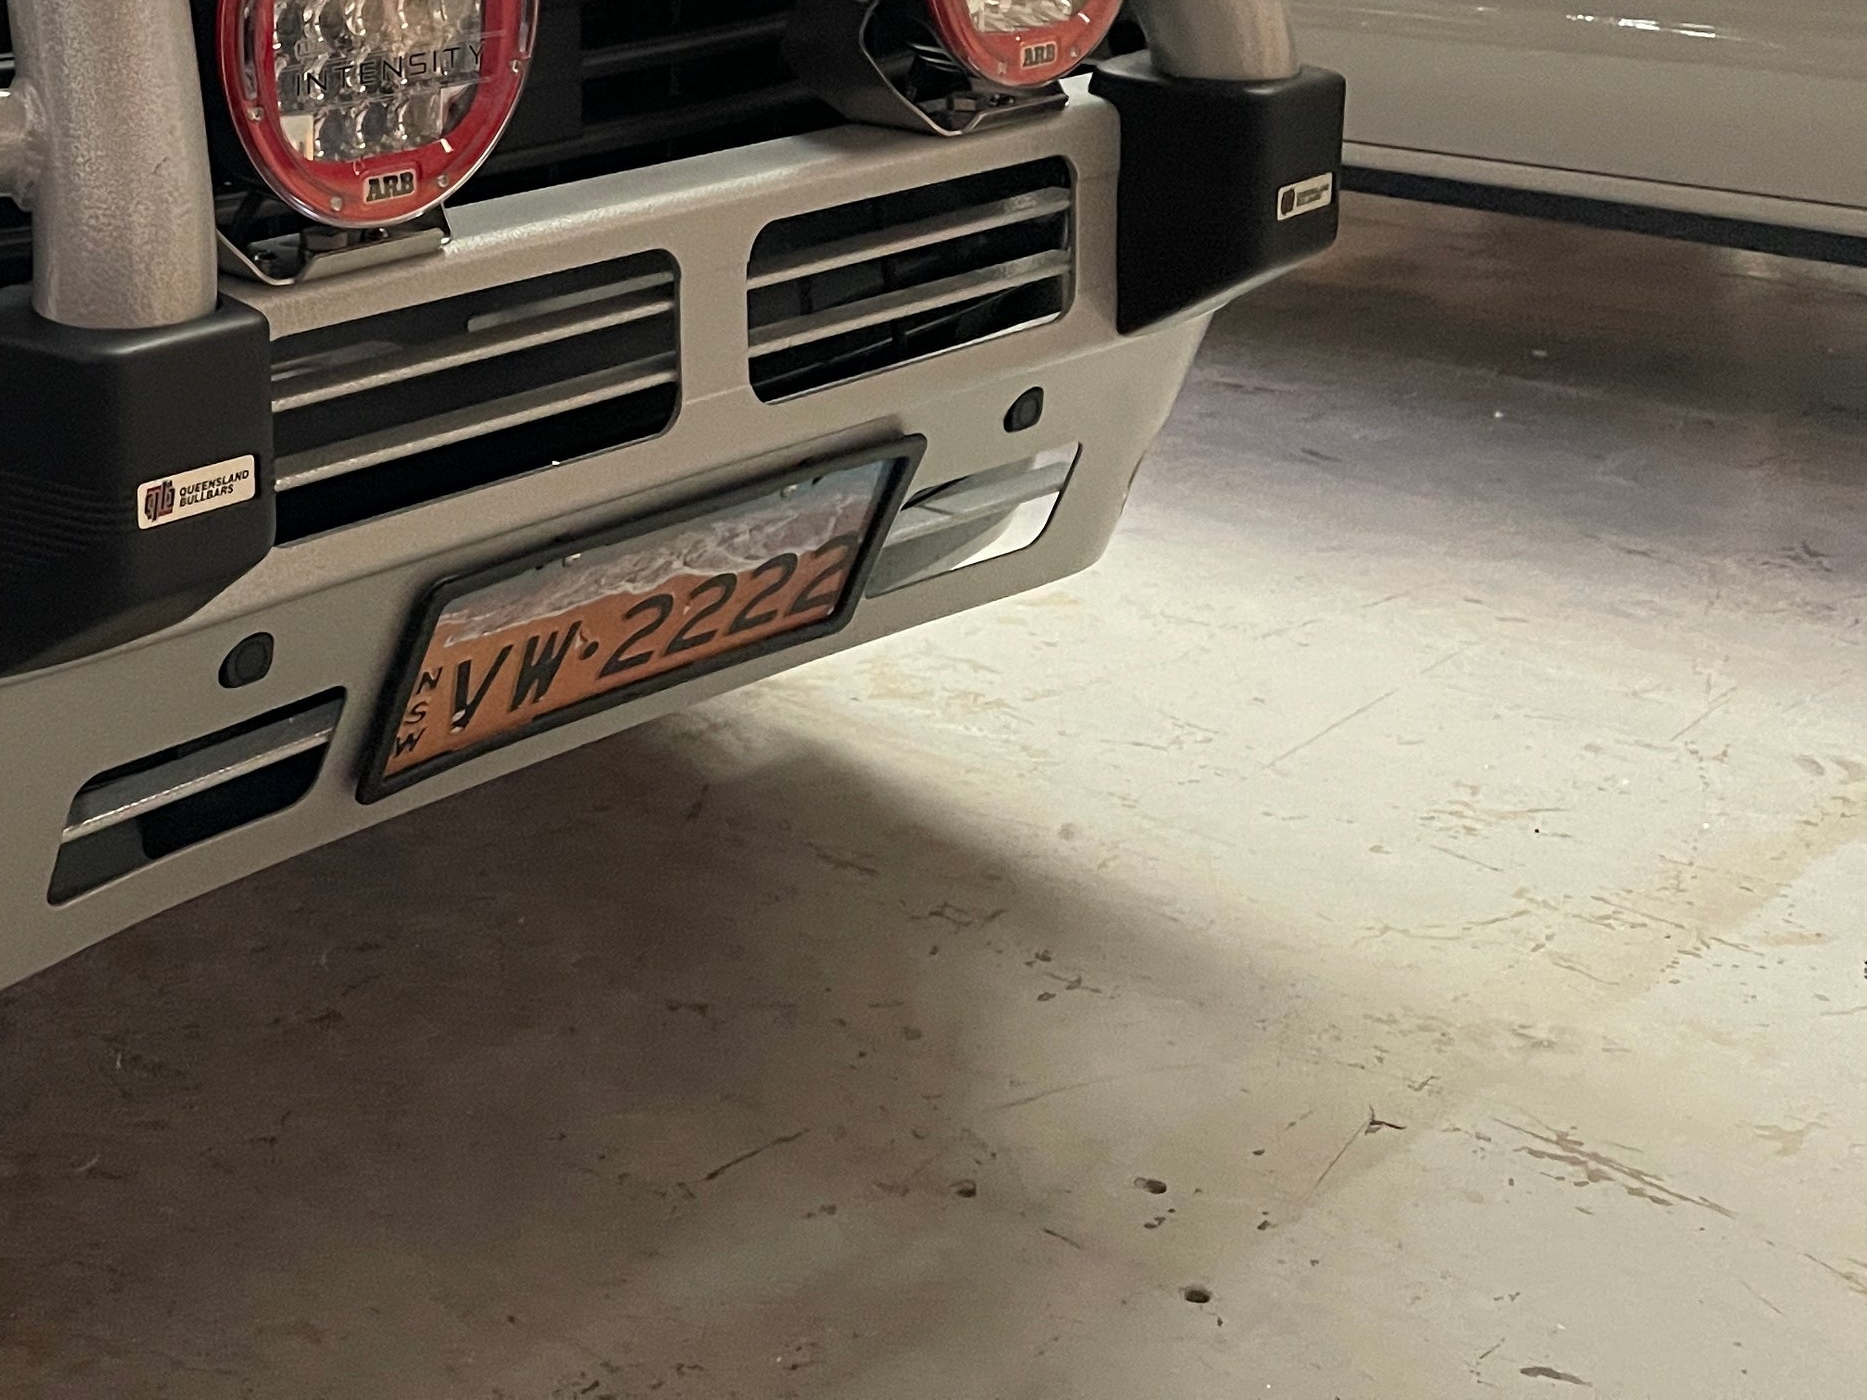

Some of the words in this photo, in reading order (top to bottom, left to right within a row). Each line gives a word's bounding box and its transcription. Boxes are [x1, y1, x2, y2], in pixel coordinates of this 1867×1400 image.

[295, 43, 485, 97] INTENSITY
[365, 171, 415, 203] ARB
[179, 469, 250, 497] QUEENSLAND
[179, 484, 235, 508] BULLBARS
